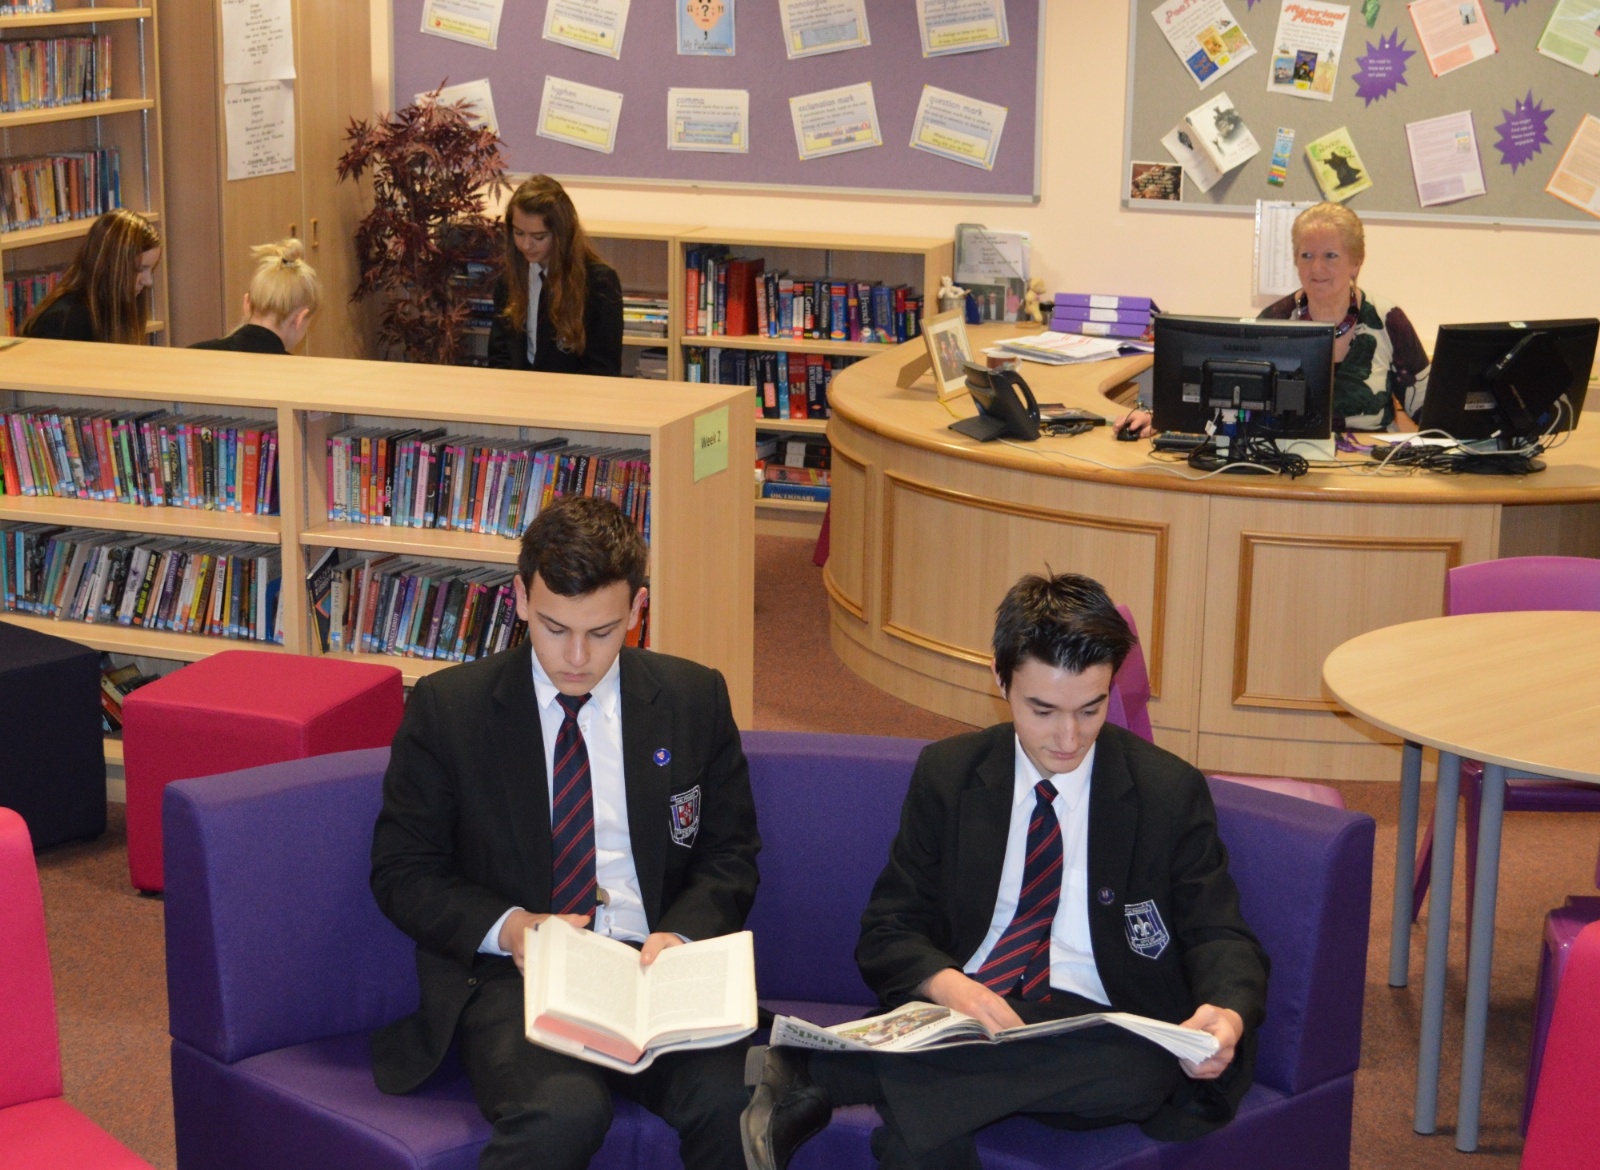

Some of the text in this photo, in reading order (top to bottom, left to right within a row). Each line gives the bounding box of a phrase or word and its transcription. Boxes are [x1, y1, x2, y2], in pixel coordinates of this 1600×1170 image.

[1284, 4, 1347, 20] Historical
[1291, 14, 1335, 27] Fiction
[797, 94, 854, 112] exclamation mark
[927, 95, 983, 117] question mark
[805, 296, 814, 329] German
[861, 297, 871, 324] French
[1223, 344, 1262, 352] SAMSUNG
[809, 366, 817, 402] ENCYCLOPEDIA
[700, 429, 721, 449] Week 2
[770, 493, 815, 502] DICTIONARY
[332, 585, 340, 608] SOVAY
